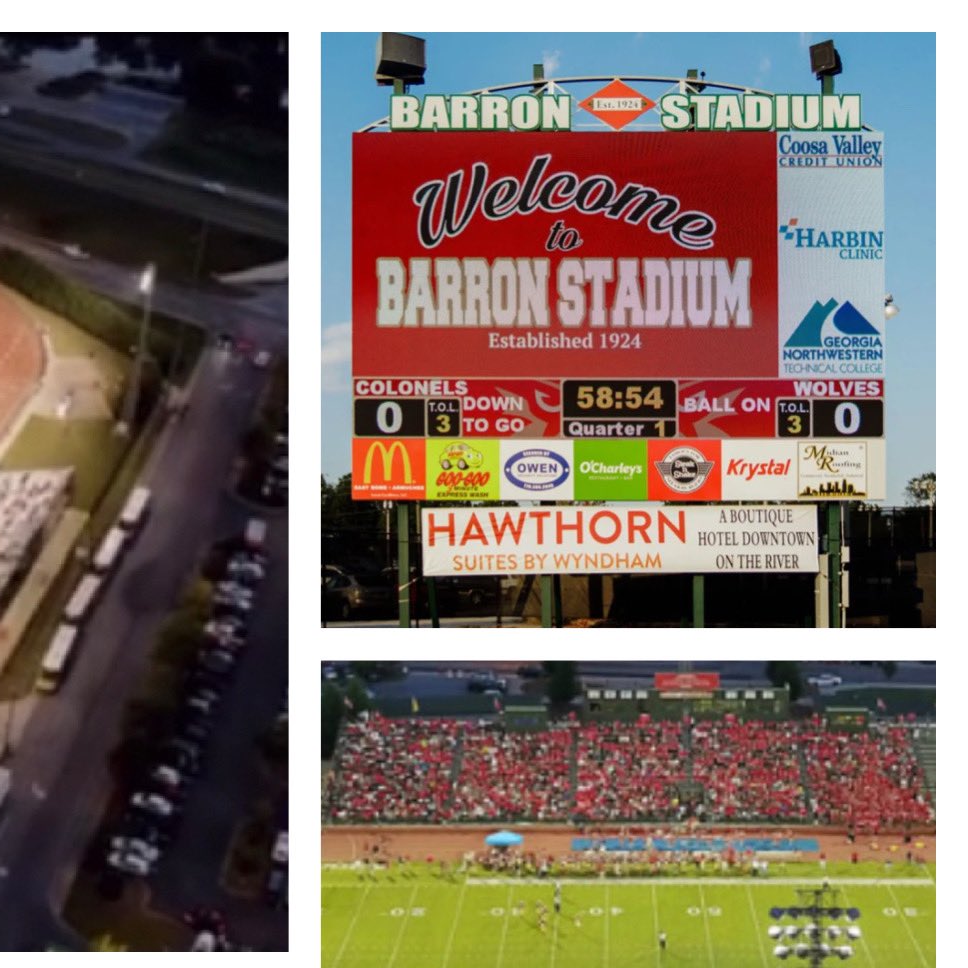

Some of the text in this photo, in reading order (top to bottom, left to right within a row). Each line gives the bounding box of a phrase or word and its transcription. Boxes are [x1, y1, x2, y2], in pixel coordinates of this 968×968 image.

[390, 94, 572, 132] BARRON
[660, 93, 862, 132] STADIUM
[779, 135, 882, 159] Coosa Valley
[779, 157, 882, 167] CREDIT UNION
[413, 153, 716, 250] Welcome
[545, 219, 582, 251] to
[795, 228, 883, 248] HARBIN
[839, 248, 883, 260] CLINIC
[376, 257, 752, 328] BARRON STADIUM
[488, 331, 641, 349] Established 1924
[824, 337, 883, 348] GEORGIA
[783, 349, 883, 361] NORTHWESTERN
[784, 363, 883, 374] TECHNICAL COLLEGE
[355, 380, 468, 395] COLONELS
[793, 381, 880, 396] WOLVES
[463, 397, 523, 411] DOWN
[576, 386, 664, 409] 58:54
[684, 398, 770, 412] BALL ON
[376, 401, 403, 433] 0
[436, 415, 451, 433] 3
[463, 418, 525, 432] TO GO
[787, 415, 802, 434] 3
[834, 402, 861, 434] 0
[569, 420, 665, 437] Quarter 1
[517, 463, 558, 473] OWEN
[727, 459, 791, 480] Krystal
[719, 509, 793, 527] A BOUTIQUE
[428, 510, 686, 546] HAWTHORN
[698, 531, 815, 546] HOTEL DOWNTOWN
[453, 553, 662, 571] SUITES BY WYNDHAM
[716, 554, 799, 569] ON THE RIVER
